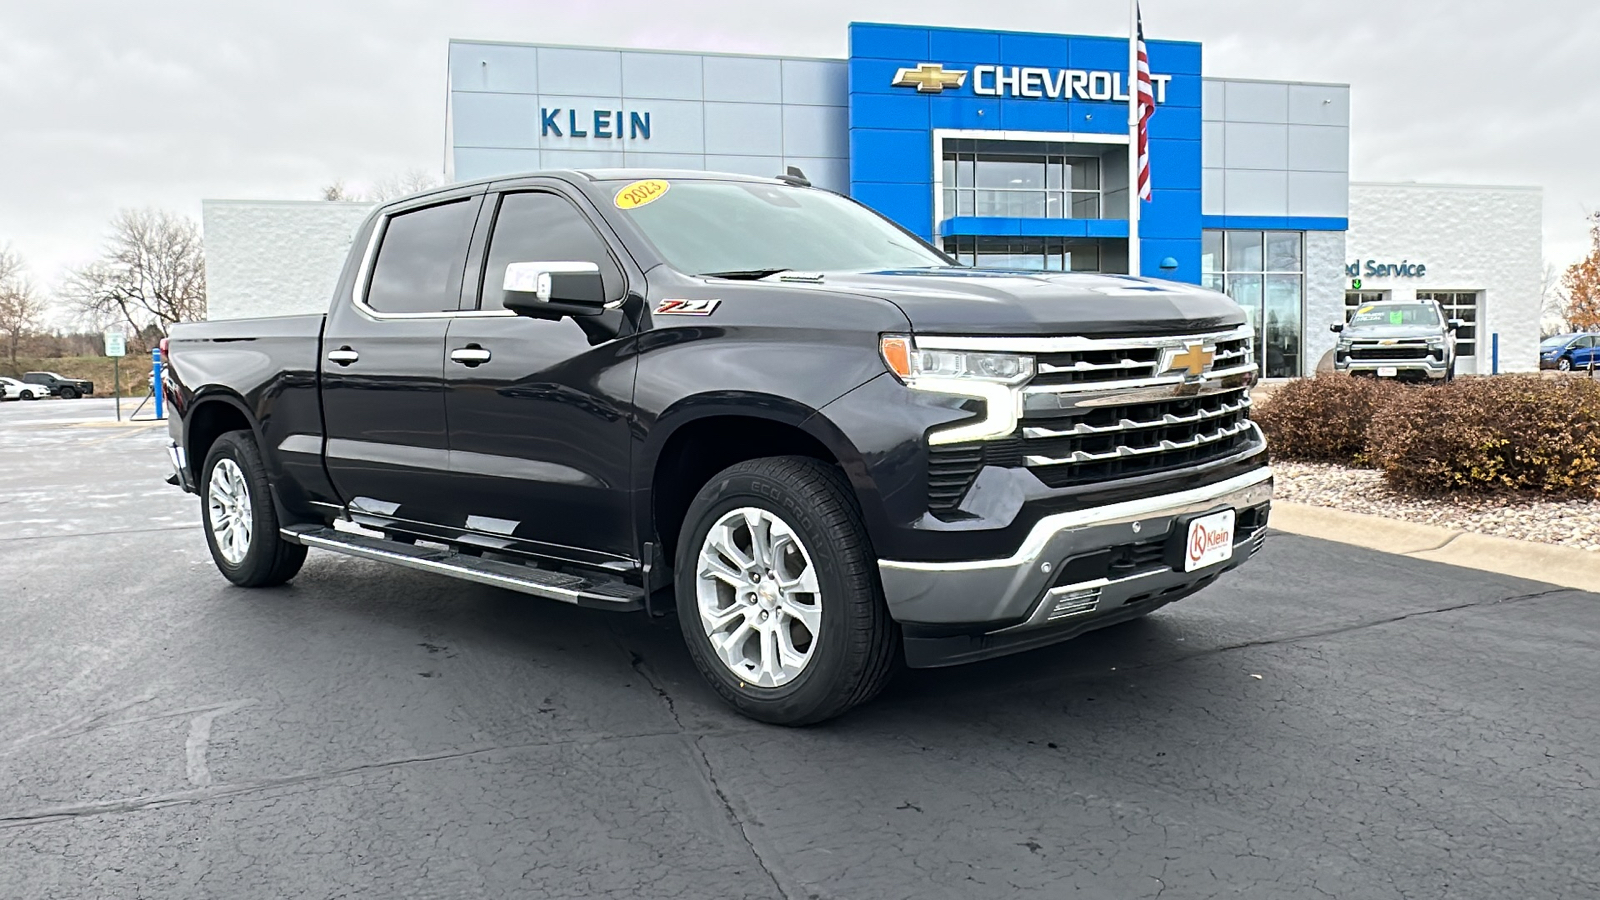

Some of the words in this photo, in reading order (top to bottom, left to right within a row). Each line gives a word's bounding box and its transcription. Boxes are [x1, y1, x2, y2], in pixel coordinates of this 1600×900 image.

[973, 64, 1172, 104] CHEVROLT
[541, 107, 651, 140] KLEIN
[624, 180, 662, 205] 2023
[1365, 259, 1426, 277] Service
[751, 481, 781, 501] ECO
[1207, 528, 1229, 547] Klein
